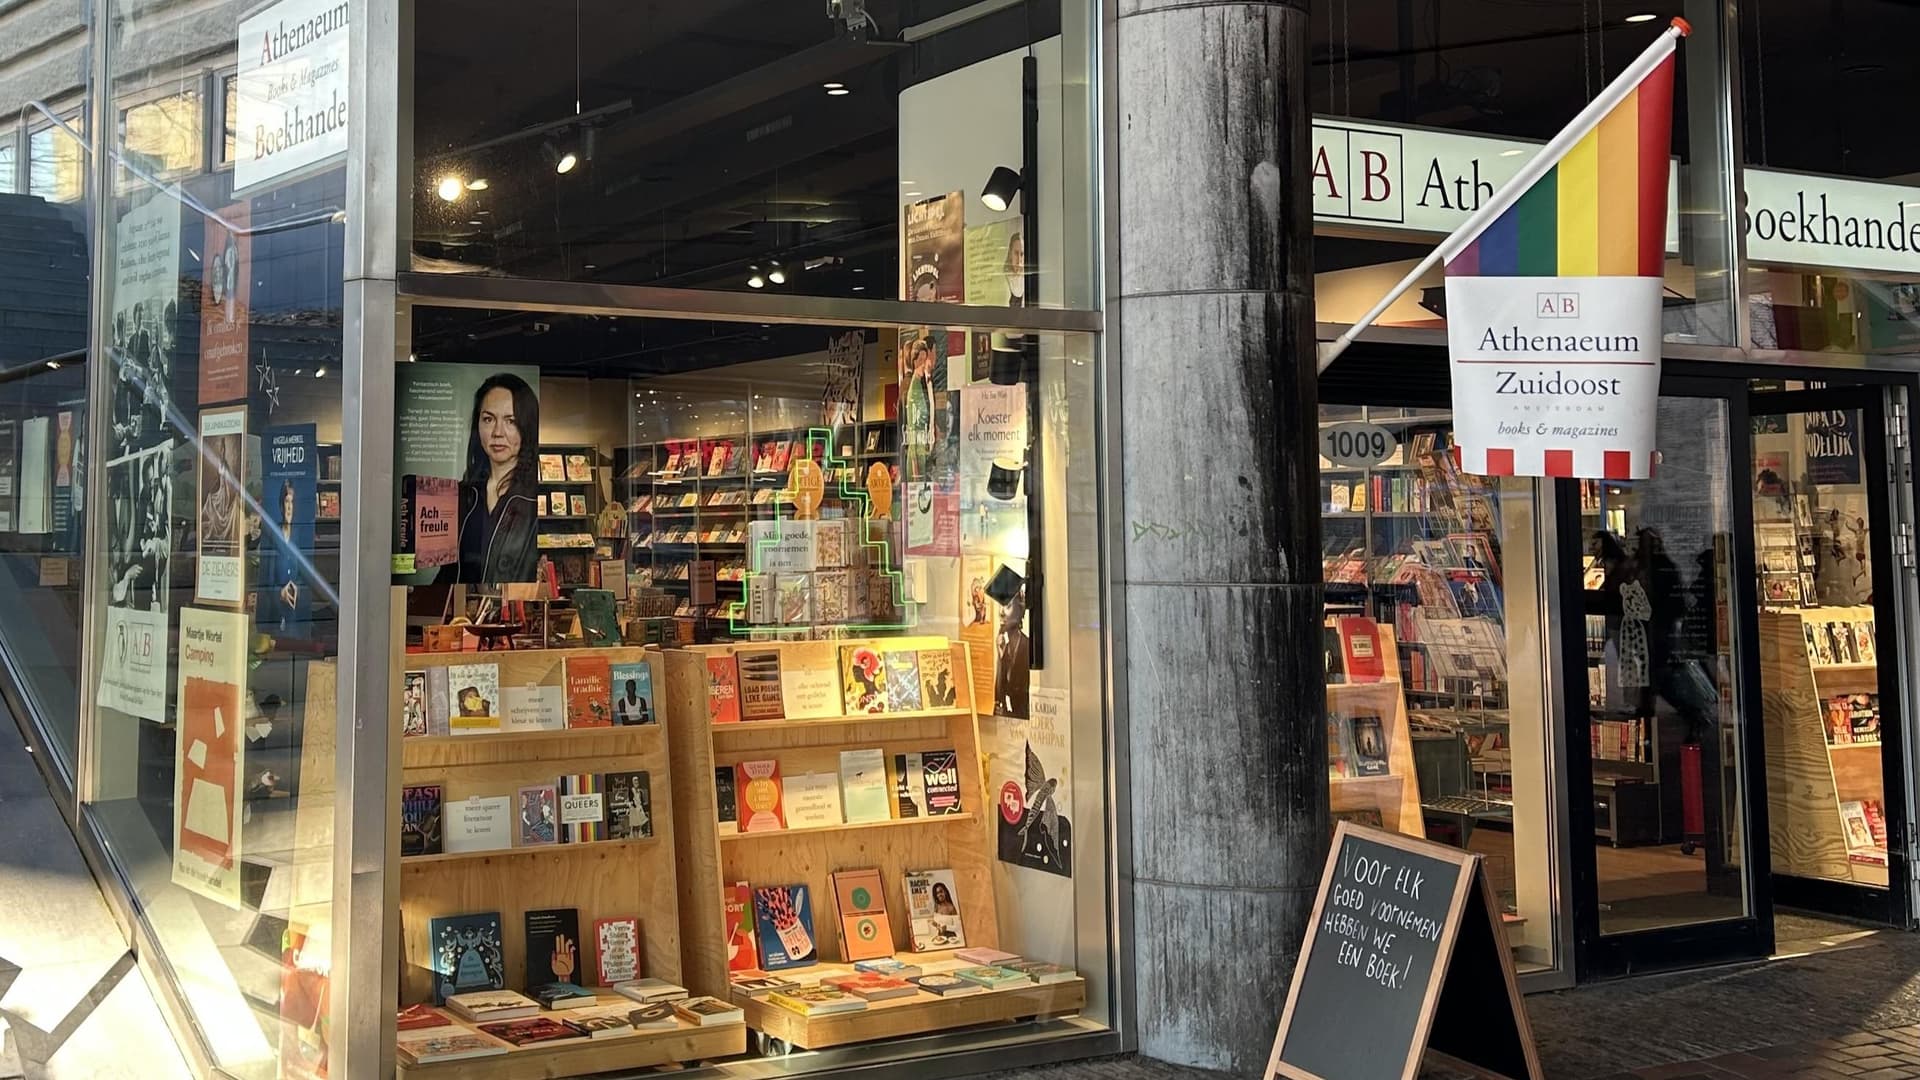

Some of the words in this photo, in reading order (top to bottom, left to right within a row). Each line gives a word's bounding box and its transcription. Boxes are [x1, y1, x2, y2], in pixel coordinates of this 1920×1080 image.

[260, 1, 350, 66] Athenaeum
[267, 77, 289, 101] Books
[290, 73, 297, 90] &
[300, 58, 340, 88] Magazines
[1477, 326, 1641, 352] Athenaeum
[1496, 371, 1621, 395] Zuidoost
[977, 407, 1012, 425] Koester
[968, 424, 981, 441] elk
[983, 430, 1020, 441] moment
[1497, 421, 1532, 436] books
[1535, 422, 1549, 436] &
[1552, 422, 1619, 439] magazines
[1327, 431, 1386, 458] 1009
[272, 446, 304, 468] VRIJHEID
[420, 506, 439, 519] Ach
[420, 520, 449, 533] freule
[784, 531, 808, 541] goede
[763, 545, 809, 553] voornemen
[186, 626, 205, 644] Maartje
[206, 628, 223, 643] Wortel
[185, 644, 214, 667] Camping
[571, 674, 601, 686] Familie
[613, 670, 649, 681] Blessings
[573, 684, 602, 694] traditie
[925, 768, 957, 786] well
[927, 784, 957, 793] connected
[564, 799, 599, 810] QUEERS
[910, 879, 930, 887] RACHEL
[1394, 866, 1425, 900] ELK
[1333, 883, 1364, 910] GOED
[1324, 911, 1369, 943] HEBBEN
[1373, 928, 1396, 954] WE
[1337, 940, 1364, 968] EEN
[1366, 953, 1414, 989] BOEK!
